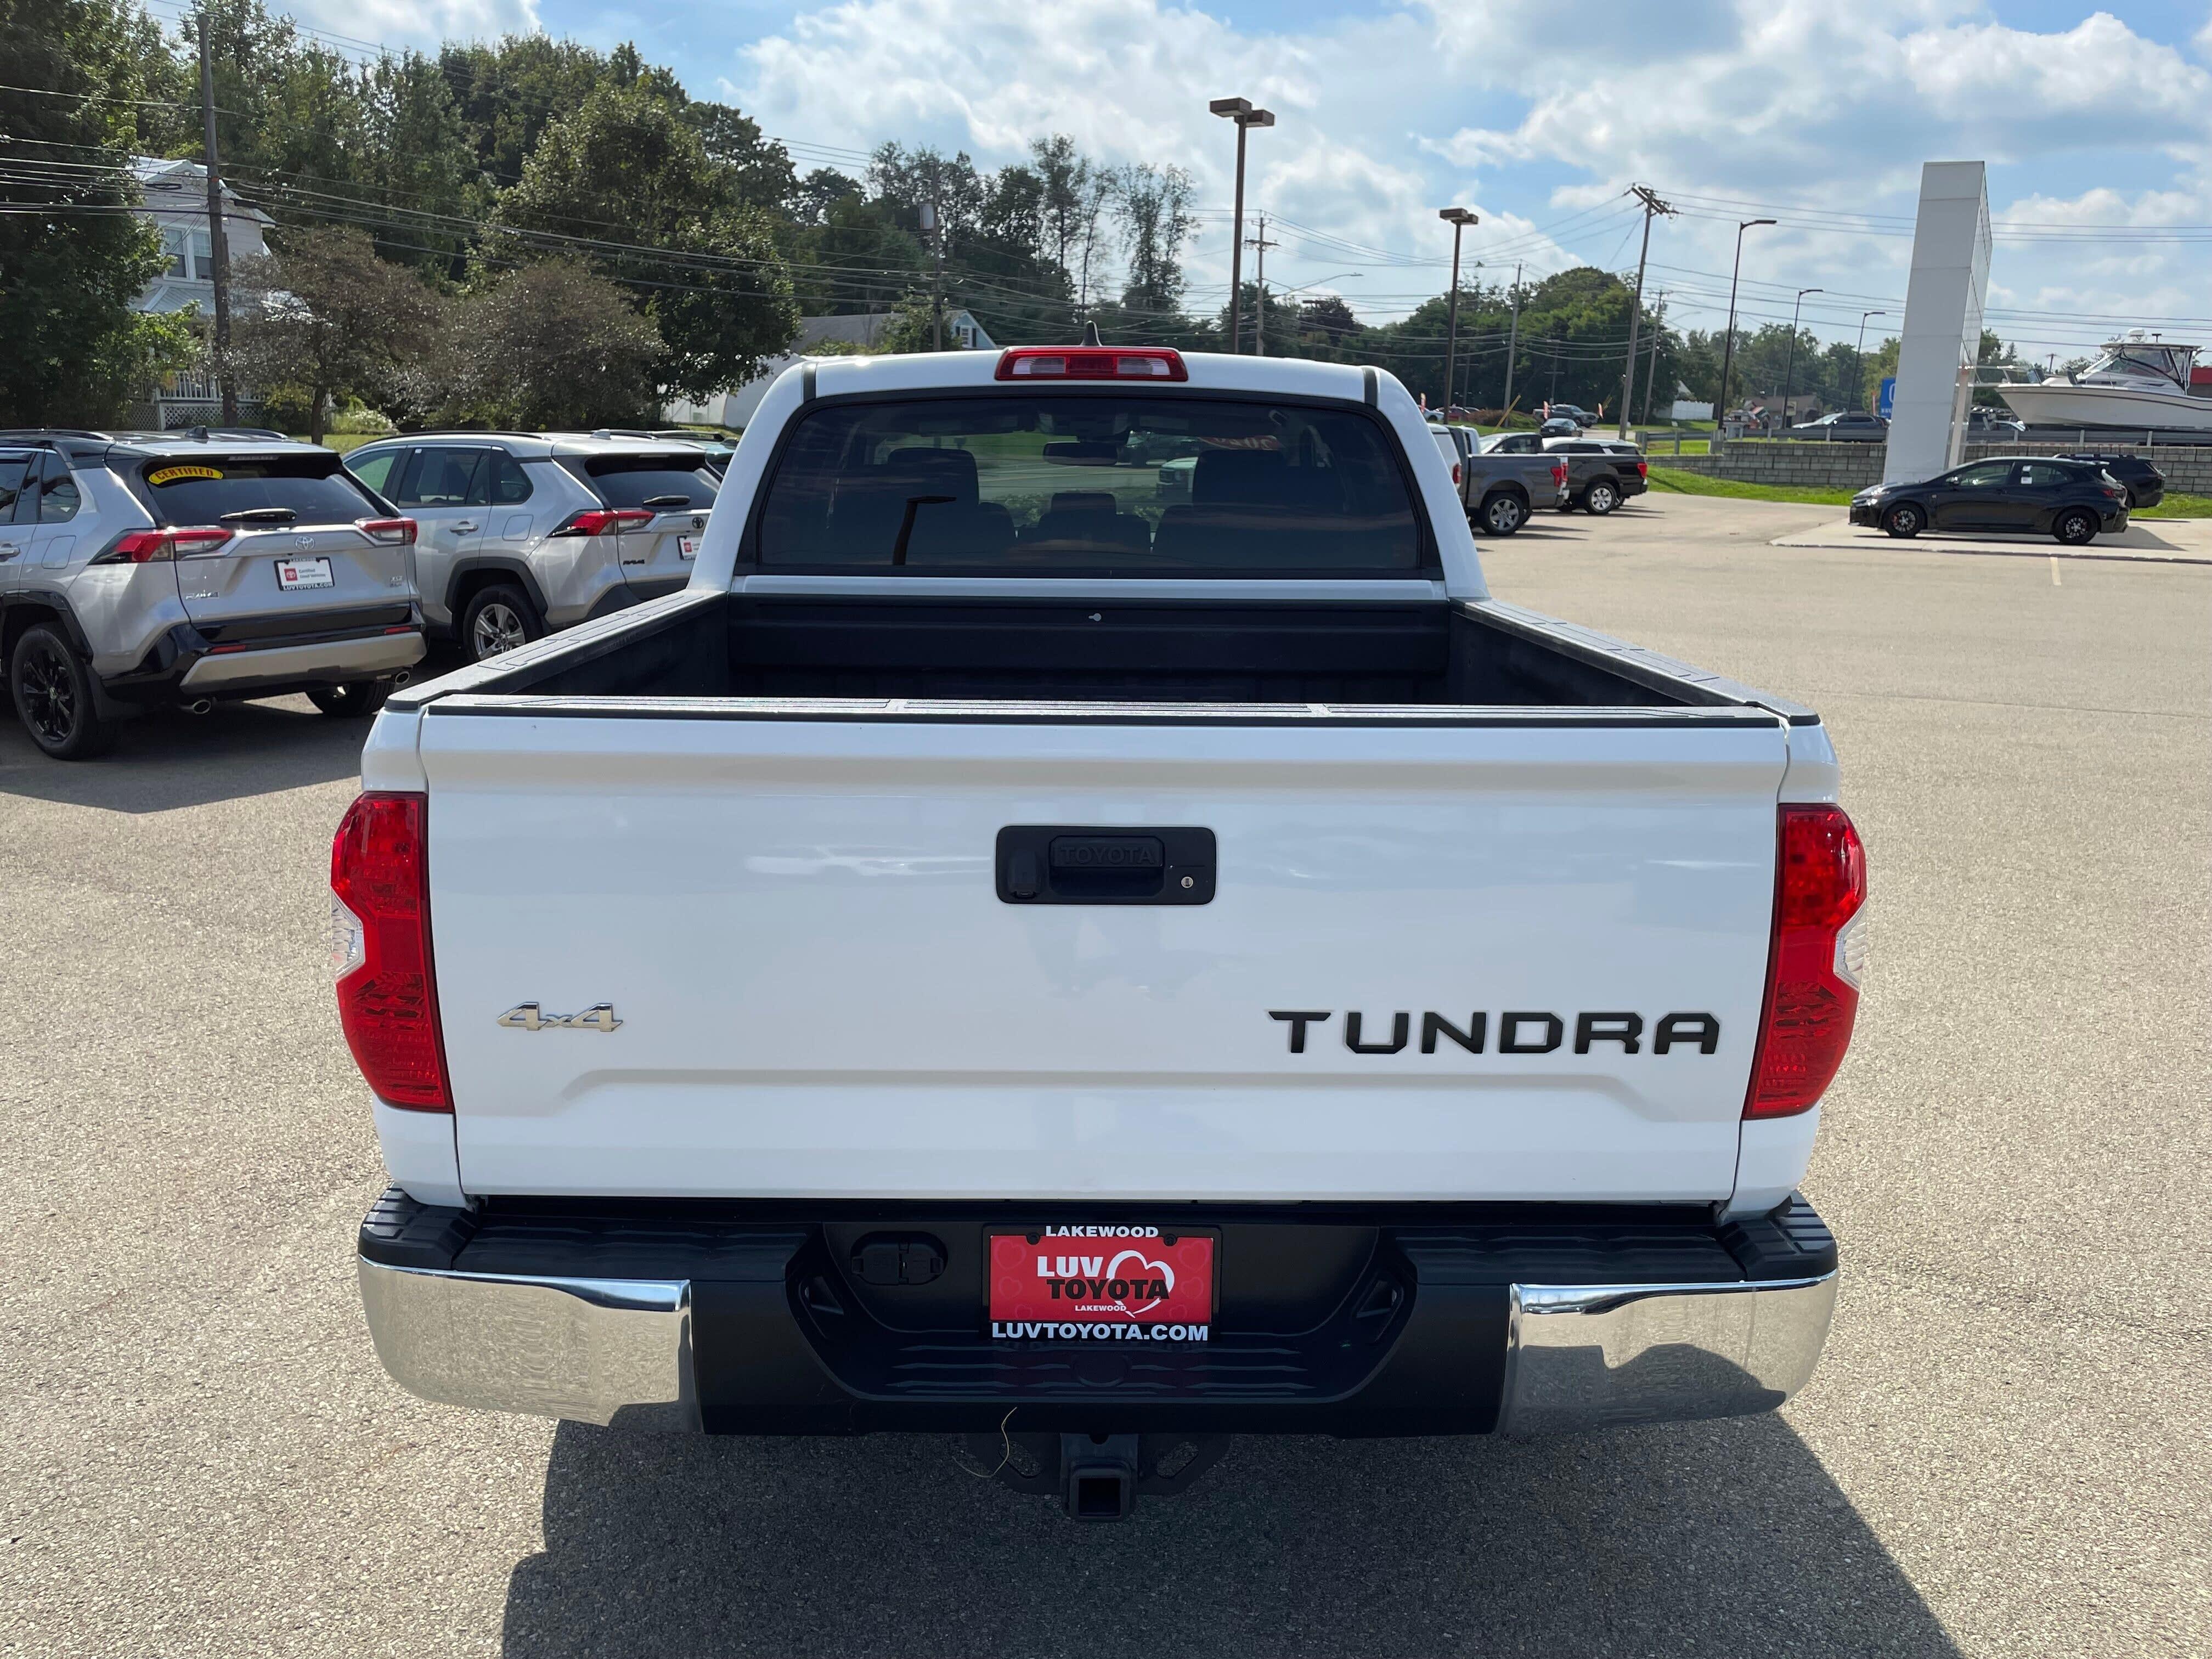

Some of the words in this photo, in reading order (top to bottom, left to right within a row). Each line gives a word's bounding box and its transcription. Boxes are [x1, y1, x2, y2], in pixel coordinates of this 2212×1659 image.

[155, 467, 213, 479] CERTIFIED
[283, 583, 334, 591] LUVTOYOTA.COM
[1061, 847, 1155, 865] TOYOTA
[496, 1001, 623, 1032] 4x4
[1268, 1011, 1720, 1055] TUNDRA
[1046, 1226, 1159, 1238] LAKEWOOD
[1037, 1256, 1103, 1277] LUV
[1047, 1279, 1170, 1300] TOYOTA
[992, 1322, 1208, 1341] LUVTOYOTA.COM
